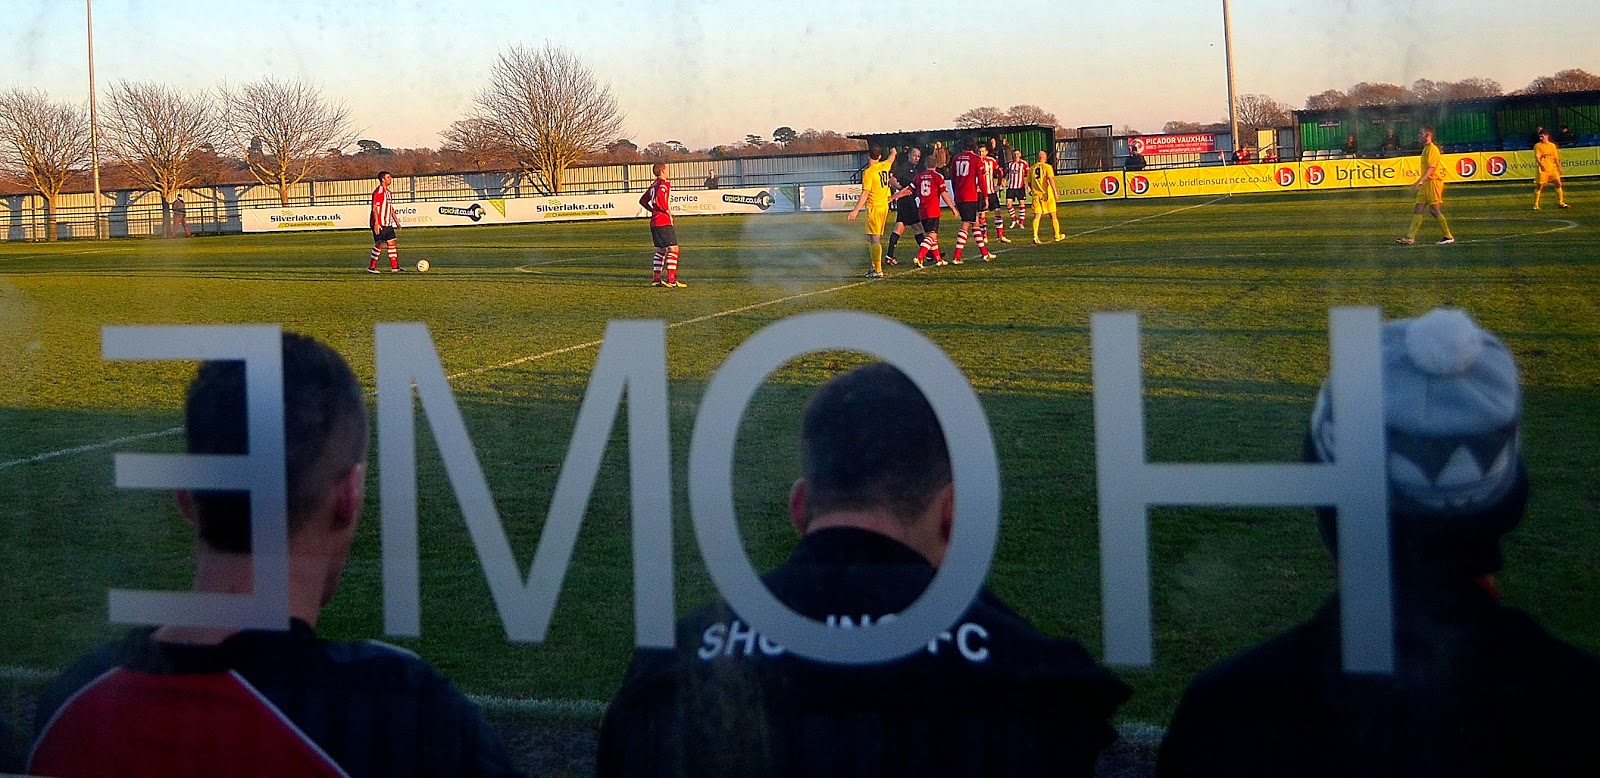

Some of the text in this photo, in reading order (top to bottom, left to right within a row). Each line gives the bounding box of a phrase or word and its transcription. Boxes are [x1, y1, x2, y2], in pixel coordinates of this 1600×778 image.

[1177, 135, 1214, 143] VAUXHALL
[957, 160, 970, 177] 10
[1035, 167, 1041, 179] 9
[1336, 164, 1395, 180] bridle
[878, 170, 888, 188] 10
[394, 207, 417, 215] ervice
[536, 202, 615, 213] Silverlake.co.uk
[270, 213, 341, 223] Silverlake.co.uk
